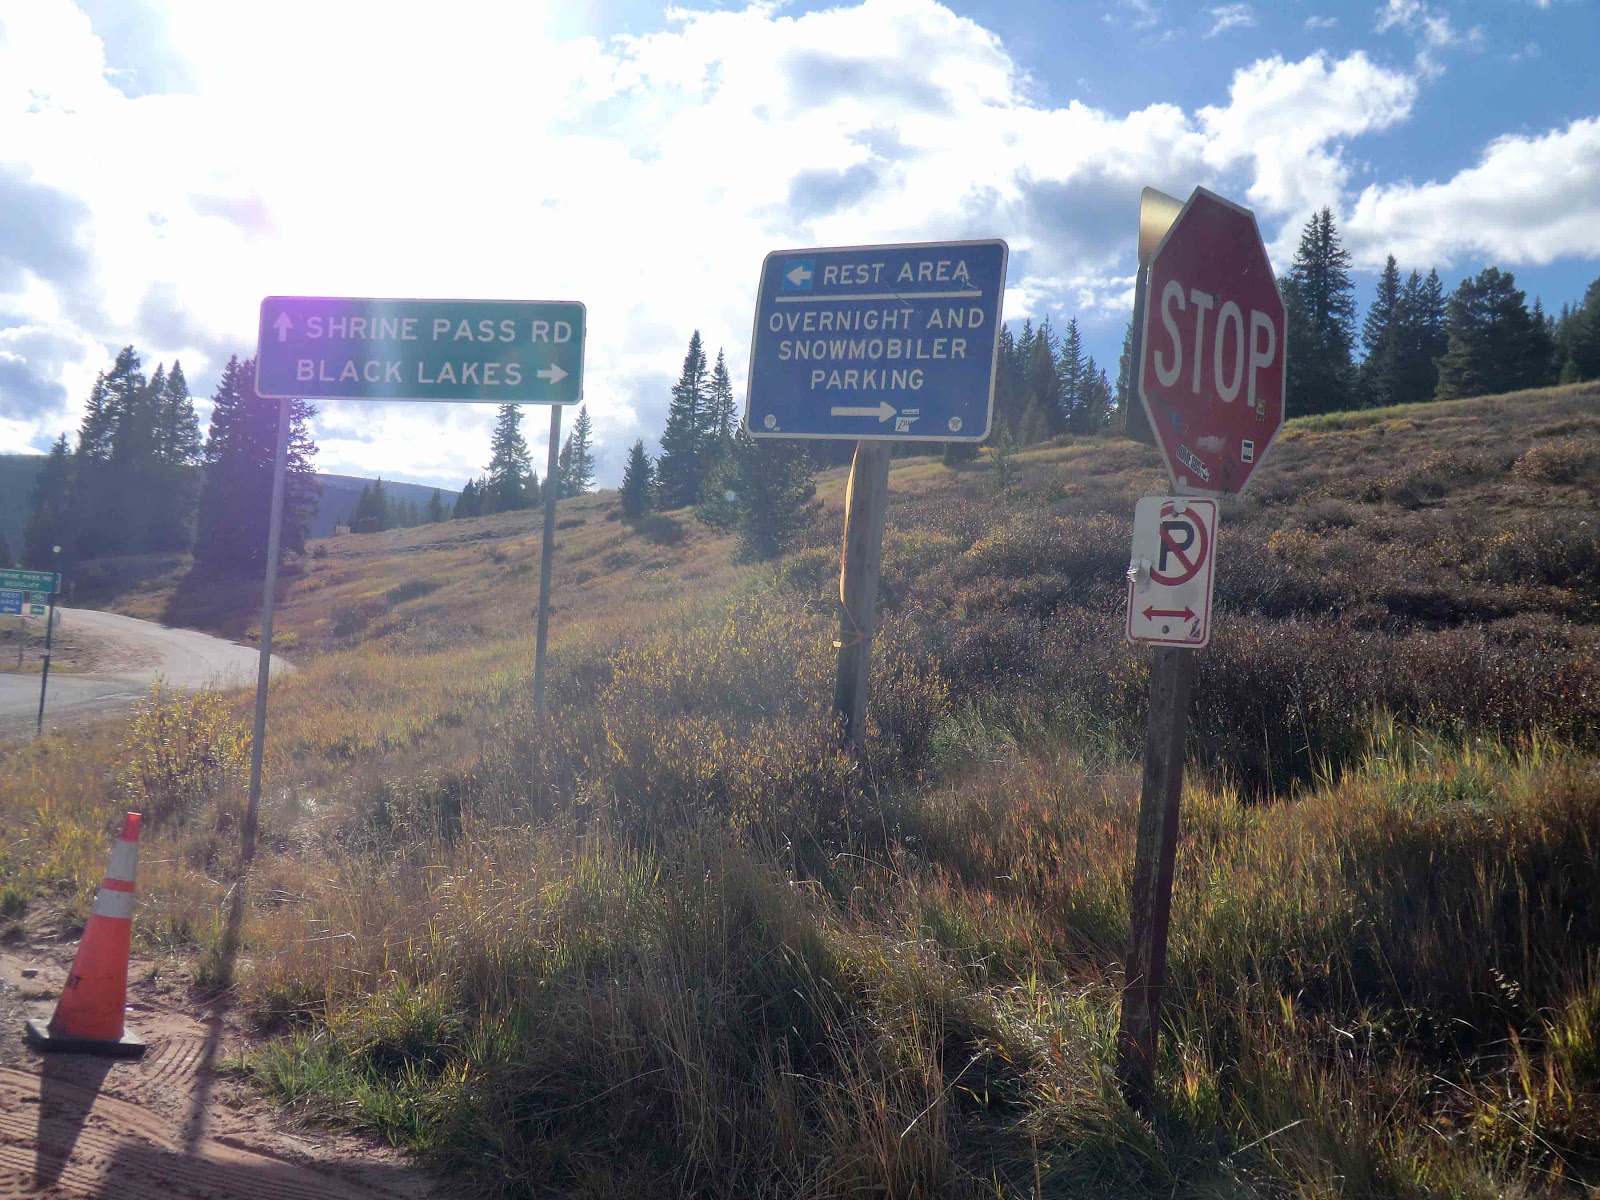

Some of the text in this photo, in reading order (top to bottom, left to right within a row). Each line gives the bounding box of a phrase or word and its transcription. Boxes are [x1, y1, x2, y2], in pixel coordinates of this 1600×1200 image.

[823, 260, 971, 286] REST AREA
[306, 316, 572, 344] SHRINE PASS RD
[769, 307, 985, 333] OVERNIGHT AND
[778, 338, 968, 361] SNOWMOBILER
[1154, 280, 1276, 408] STOP
[296, 359, 522, 386] BLACK LAKES
[810, 369, 925, 391] PARKING
